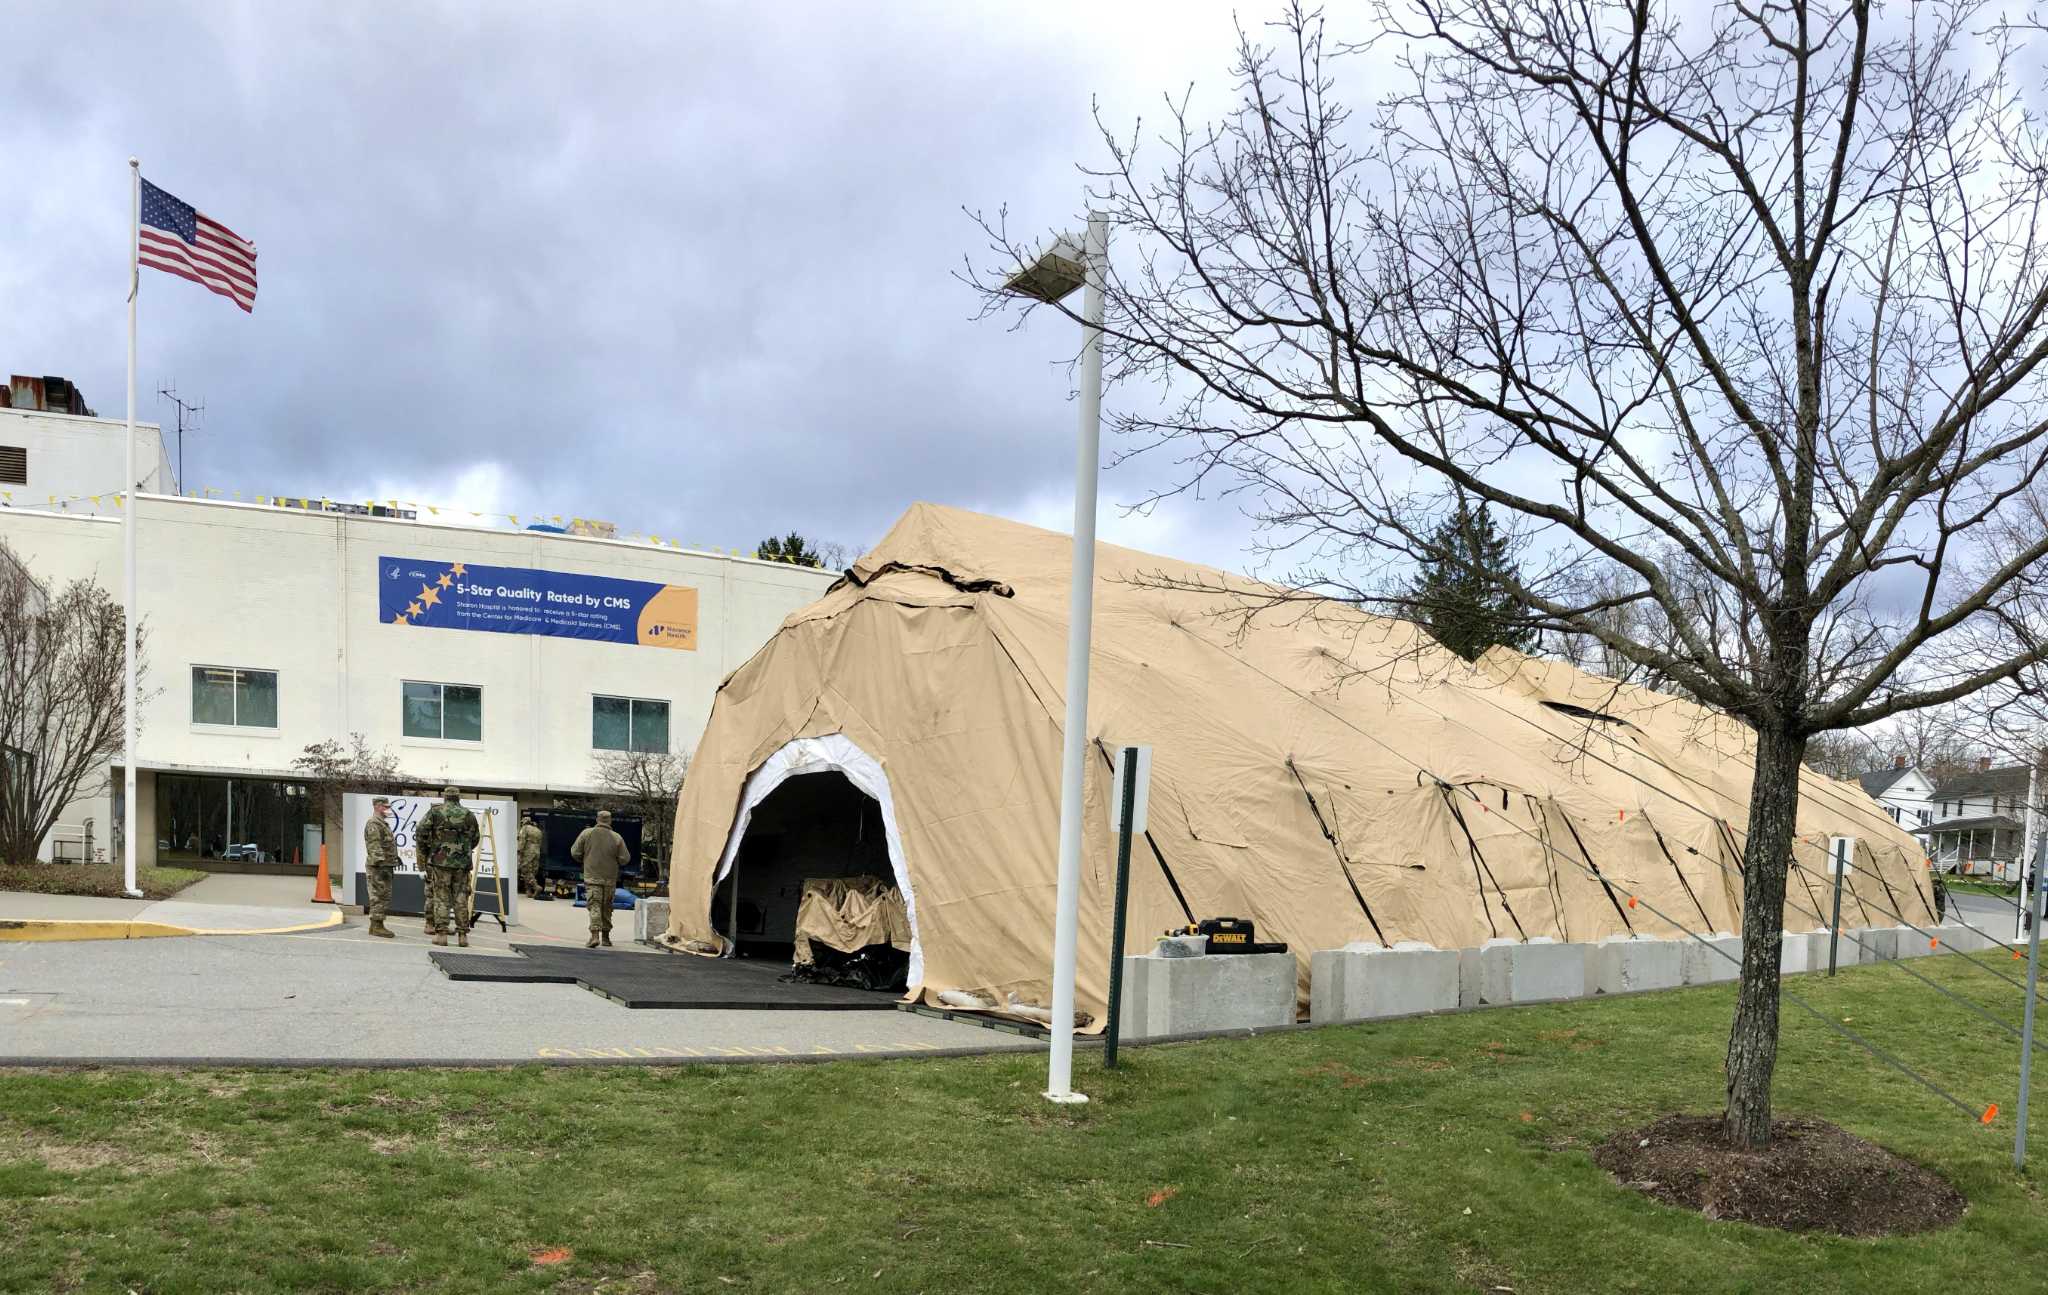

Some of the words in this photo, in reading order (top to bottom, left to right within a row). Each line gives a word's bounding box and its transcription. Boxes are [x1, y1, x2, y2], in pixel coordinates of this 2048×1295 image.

[457, 583, 493, 597] 5-Star
[496, 586, 542, 602] Quality
[547, 590, 583, 604] Rated
[585, 594, 600, 608] by
[603, 596, 631, 609] CMS
[456, 601, 478, 609] Sharon
[508, 605, 533, 613] honored
[543, 608, 564, 616] receive
[590, 613, 608, 621] rating
[514, 614, 542, 623] Medicare
[578, 621, 602, 629] Services
